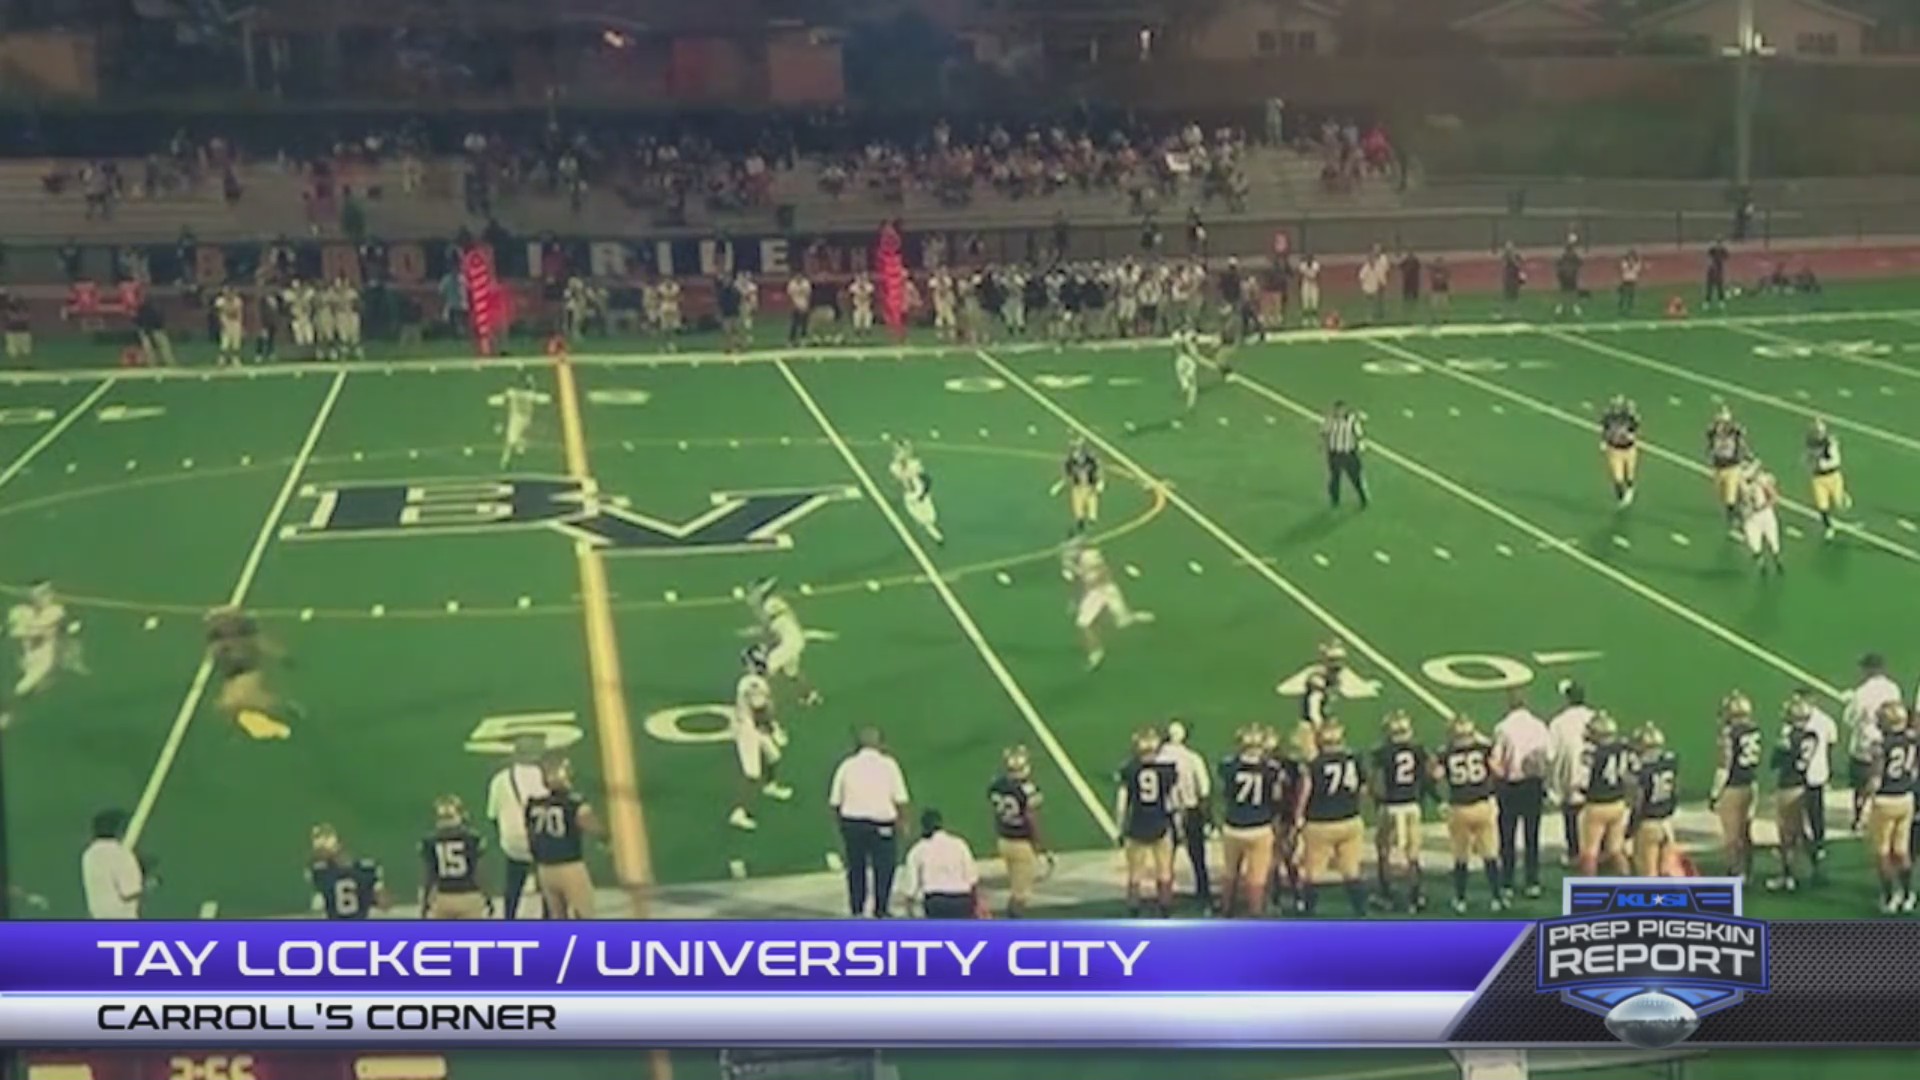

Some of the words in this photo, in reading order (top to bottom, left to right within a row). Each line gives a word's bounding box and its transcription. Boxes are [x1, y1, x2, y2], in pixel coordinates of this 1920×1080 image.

[1394, 751, 1415, 784] 2
[1138, 769, 1160, 803] 9
[1236, 772, 1263, 806] 71
[435, 841, 467, 878] 15
[335, 880, 359, 914] 6
